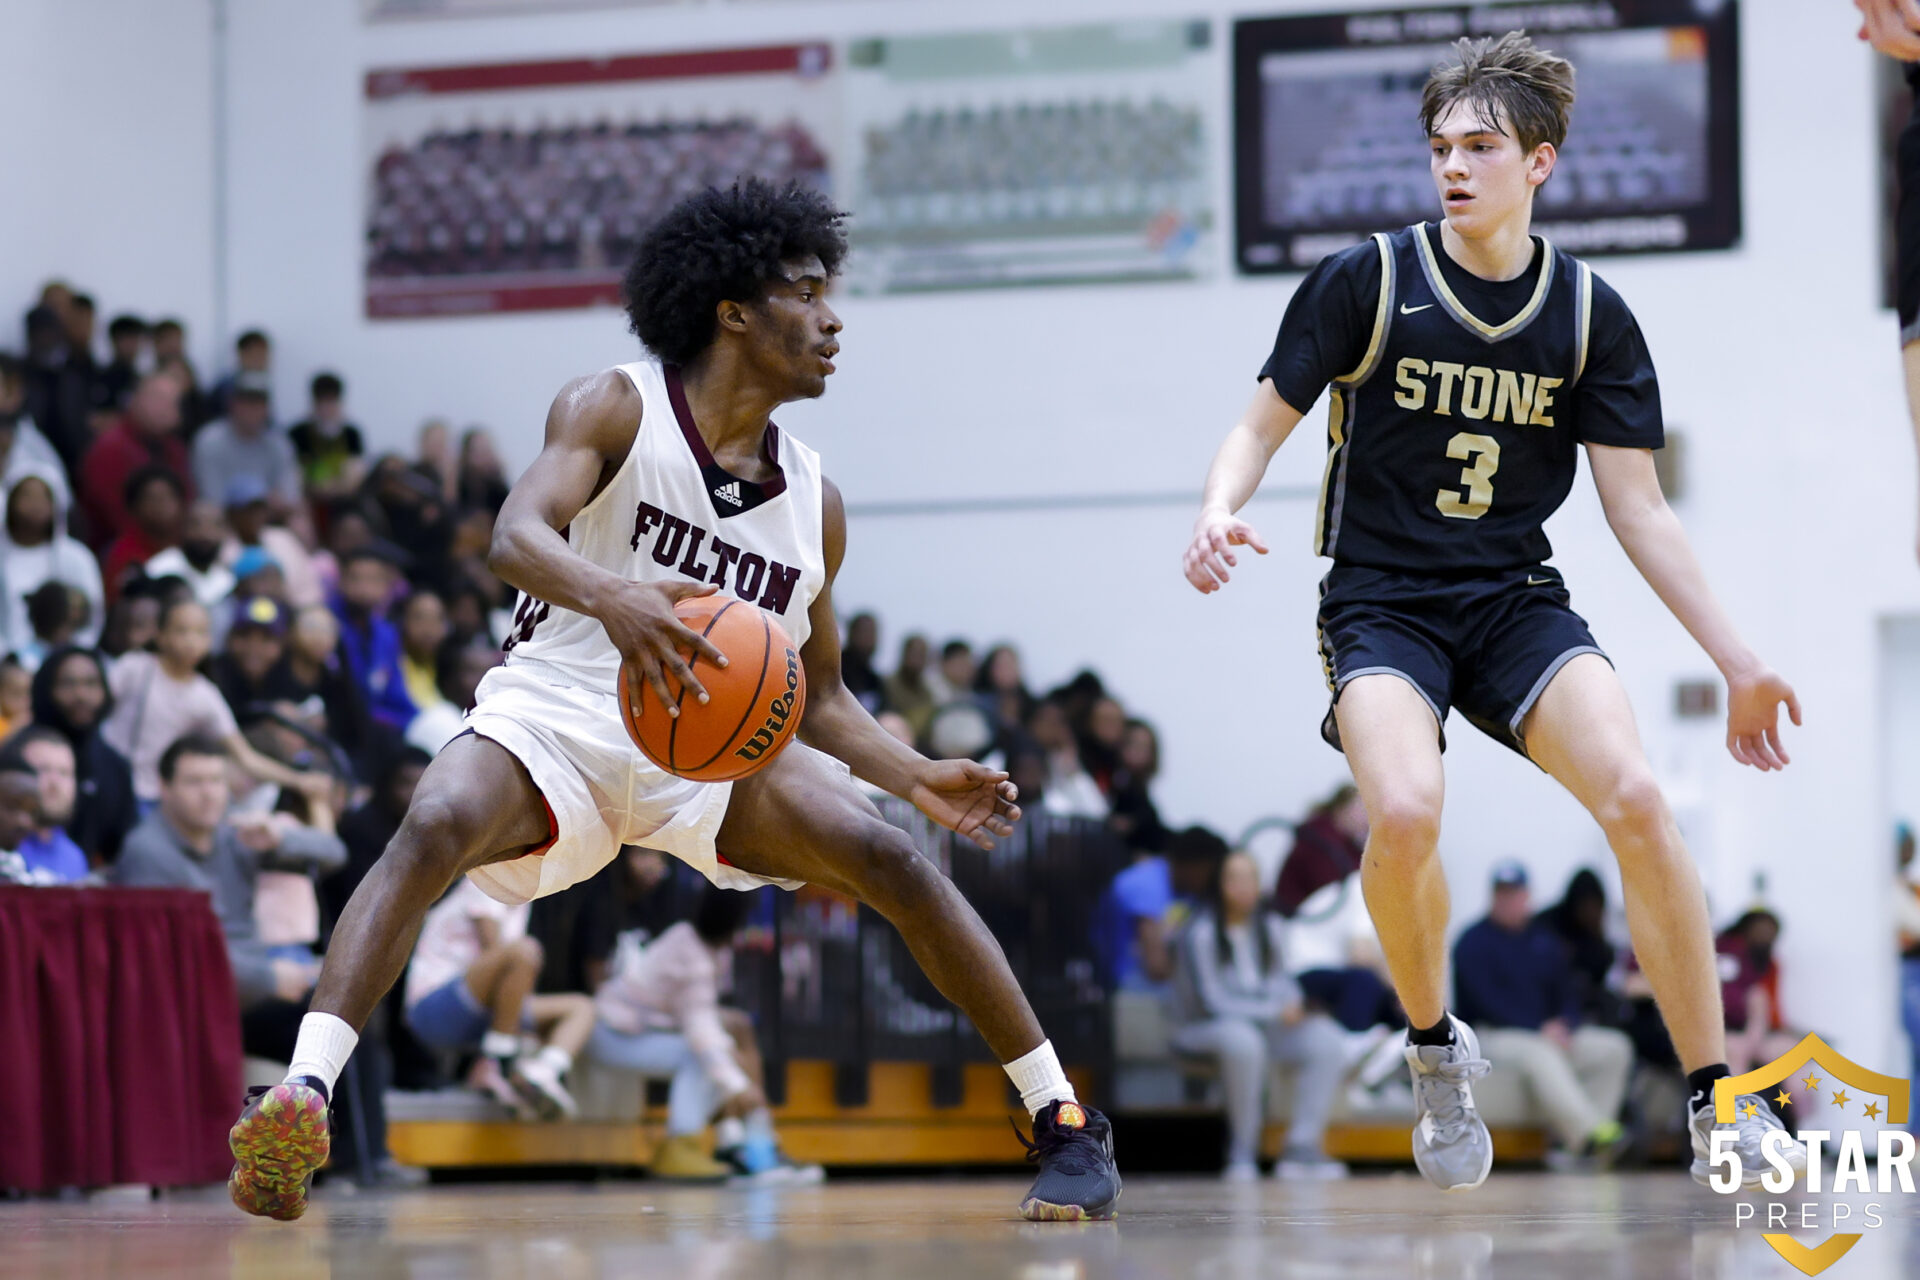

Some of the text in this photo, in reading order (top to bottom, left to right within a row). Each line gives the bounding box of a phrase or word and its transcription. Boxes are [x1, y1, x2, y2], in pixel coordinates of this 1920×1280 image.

[1395, 357, 1563, 427] STONE
[714, 488, 743, 507] adidas
[1436, 432, 1500, 520] 3
[630, 501, 801, 616] FULTON
[735, 648, 799, 762] Wilson
